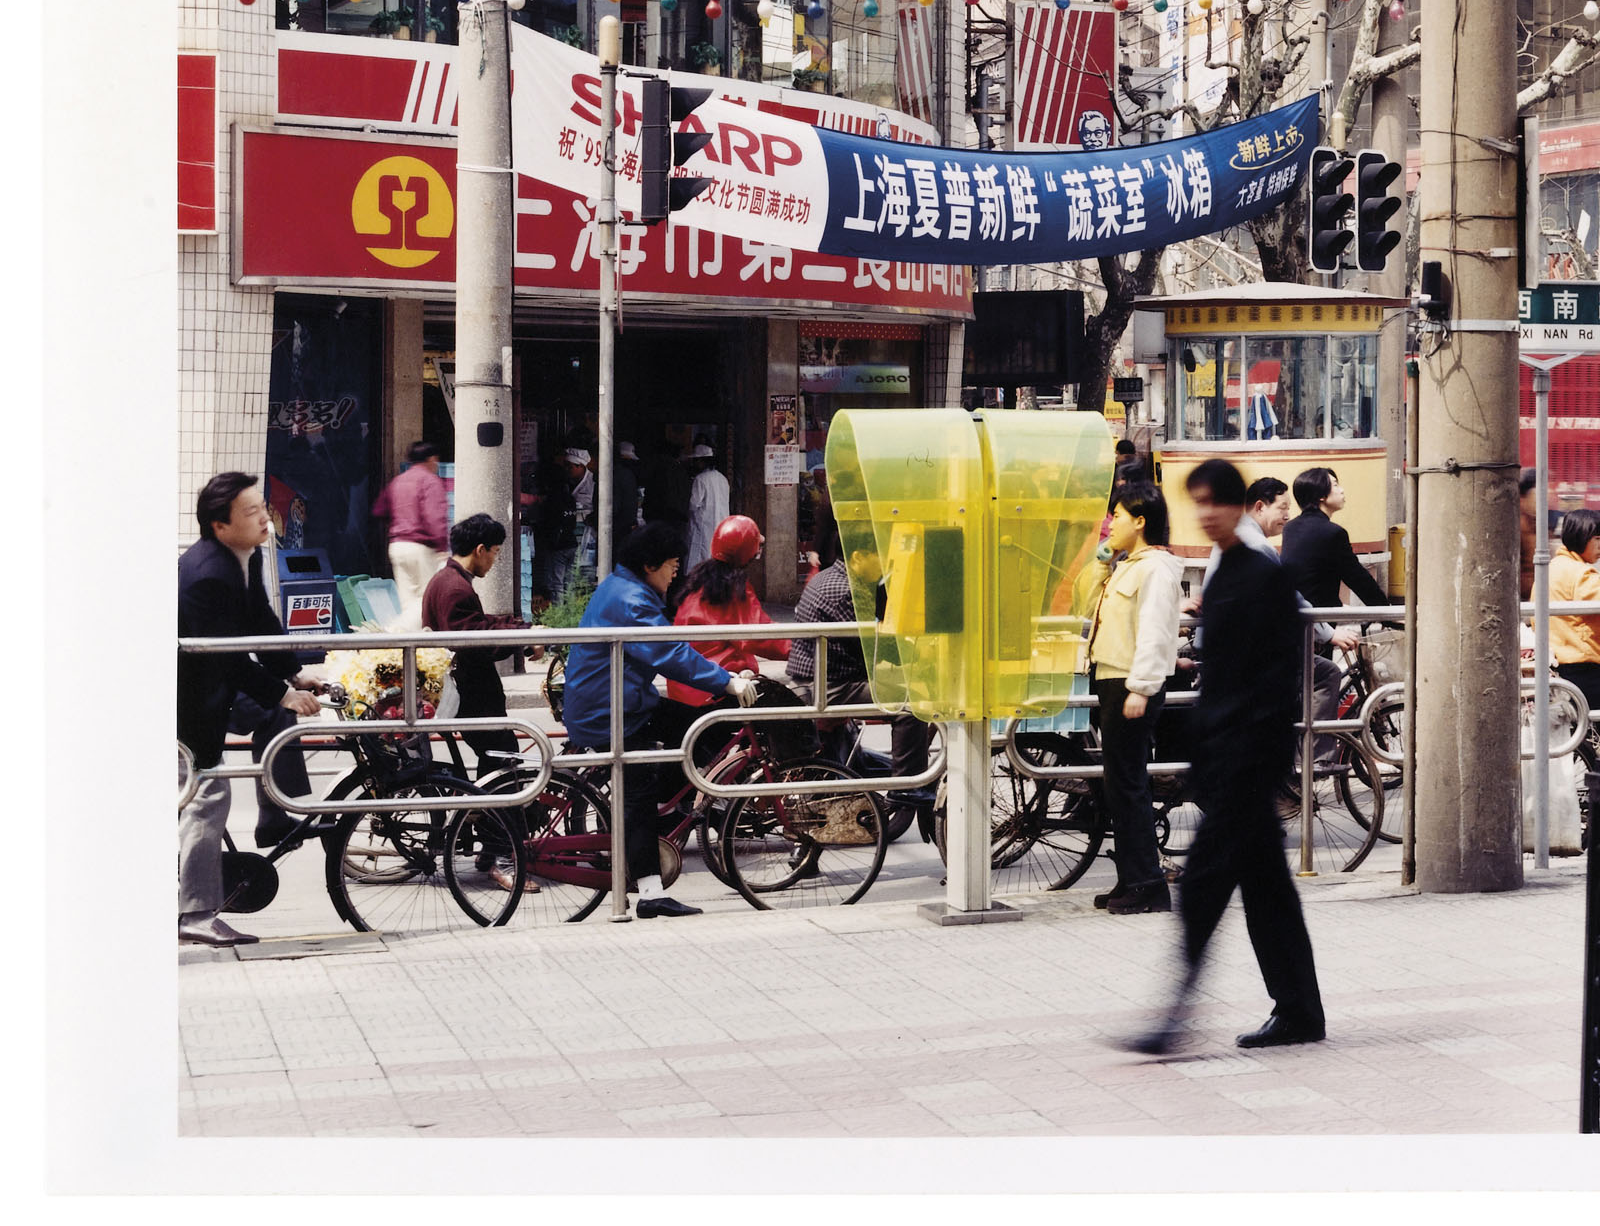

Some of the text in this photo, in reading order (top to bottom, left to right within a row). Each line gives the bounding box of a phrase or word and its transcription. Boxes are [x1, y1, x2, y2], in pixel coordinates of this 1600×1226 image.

[1237, 124, 1298, 164] 新鲜上市
[1235, 176, 1266, 209] 大容量
[1544, 329, 1568, 340] NAN
[293, 596, 331, 609] 百事可乐
